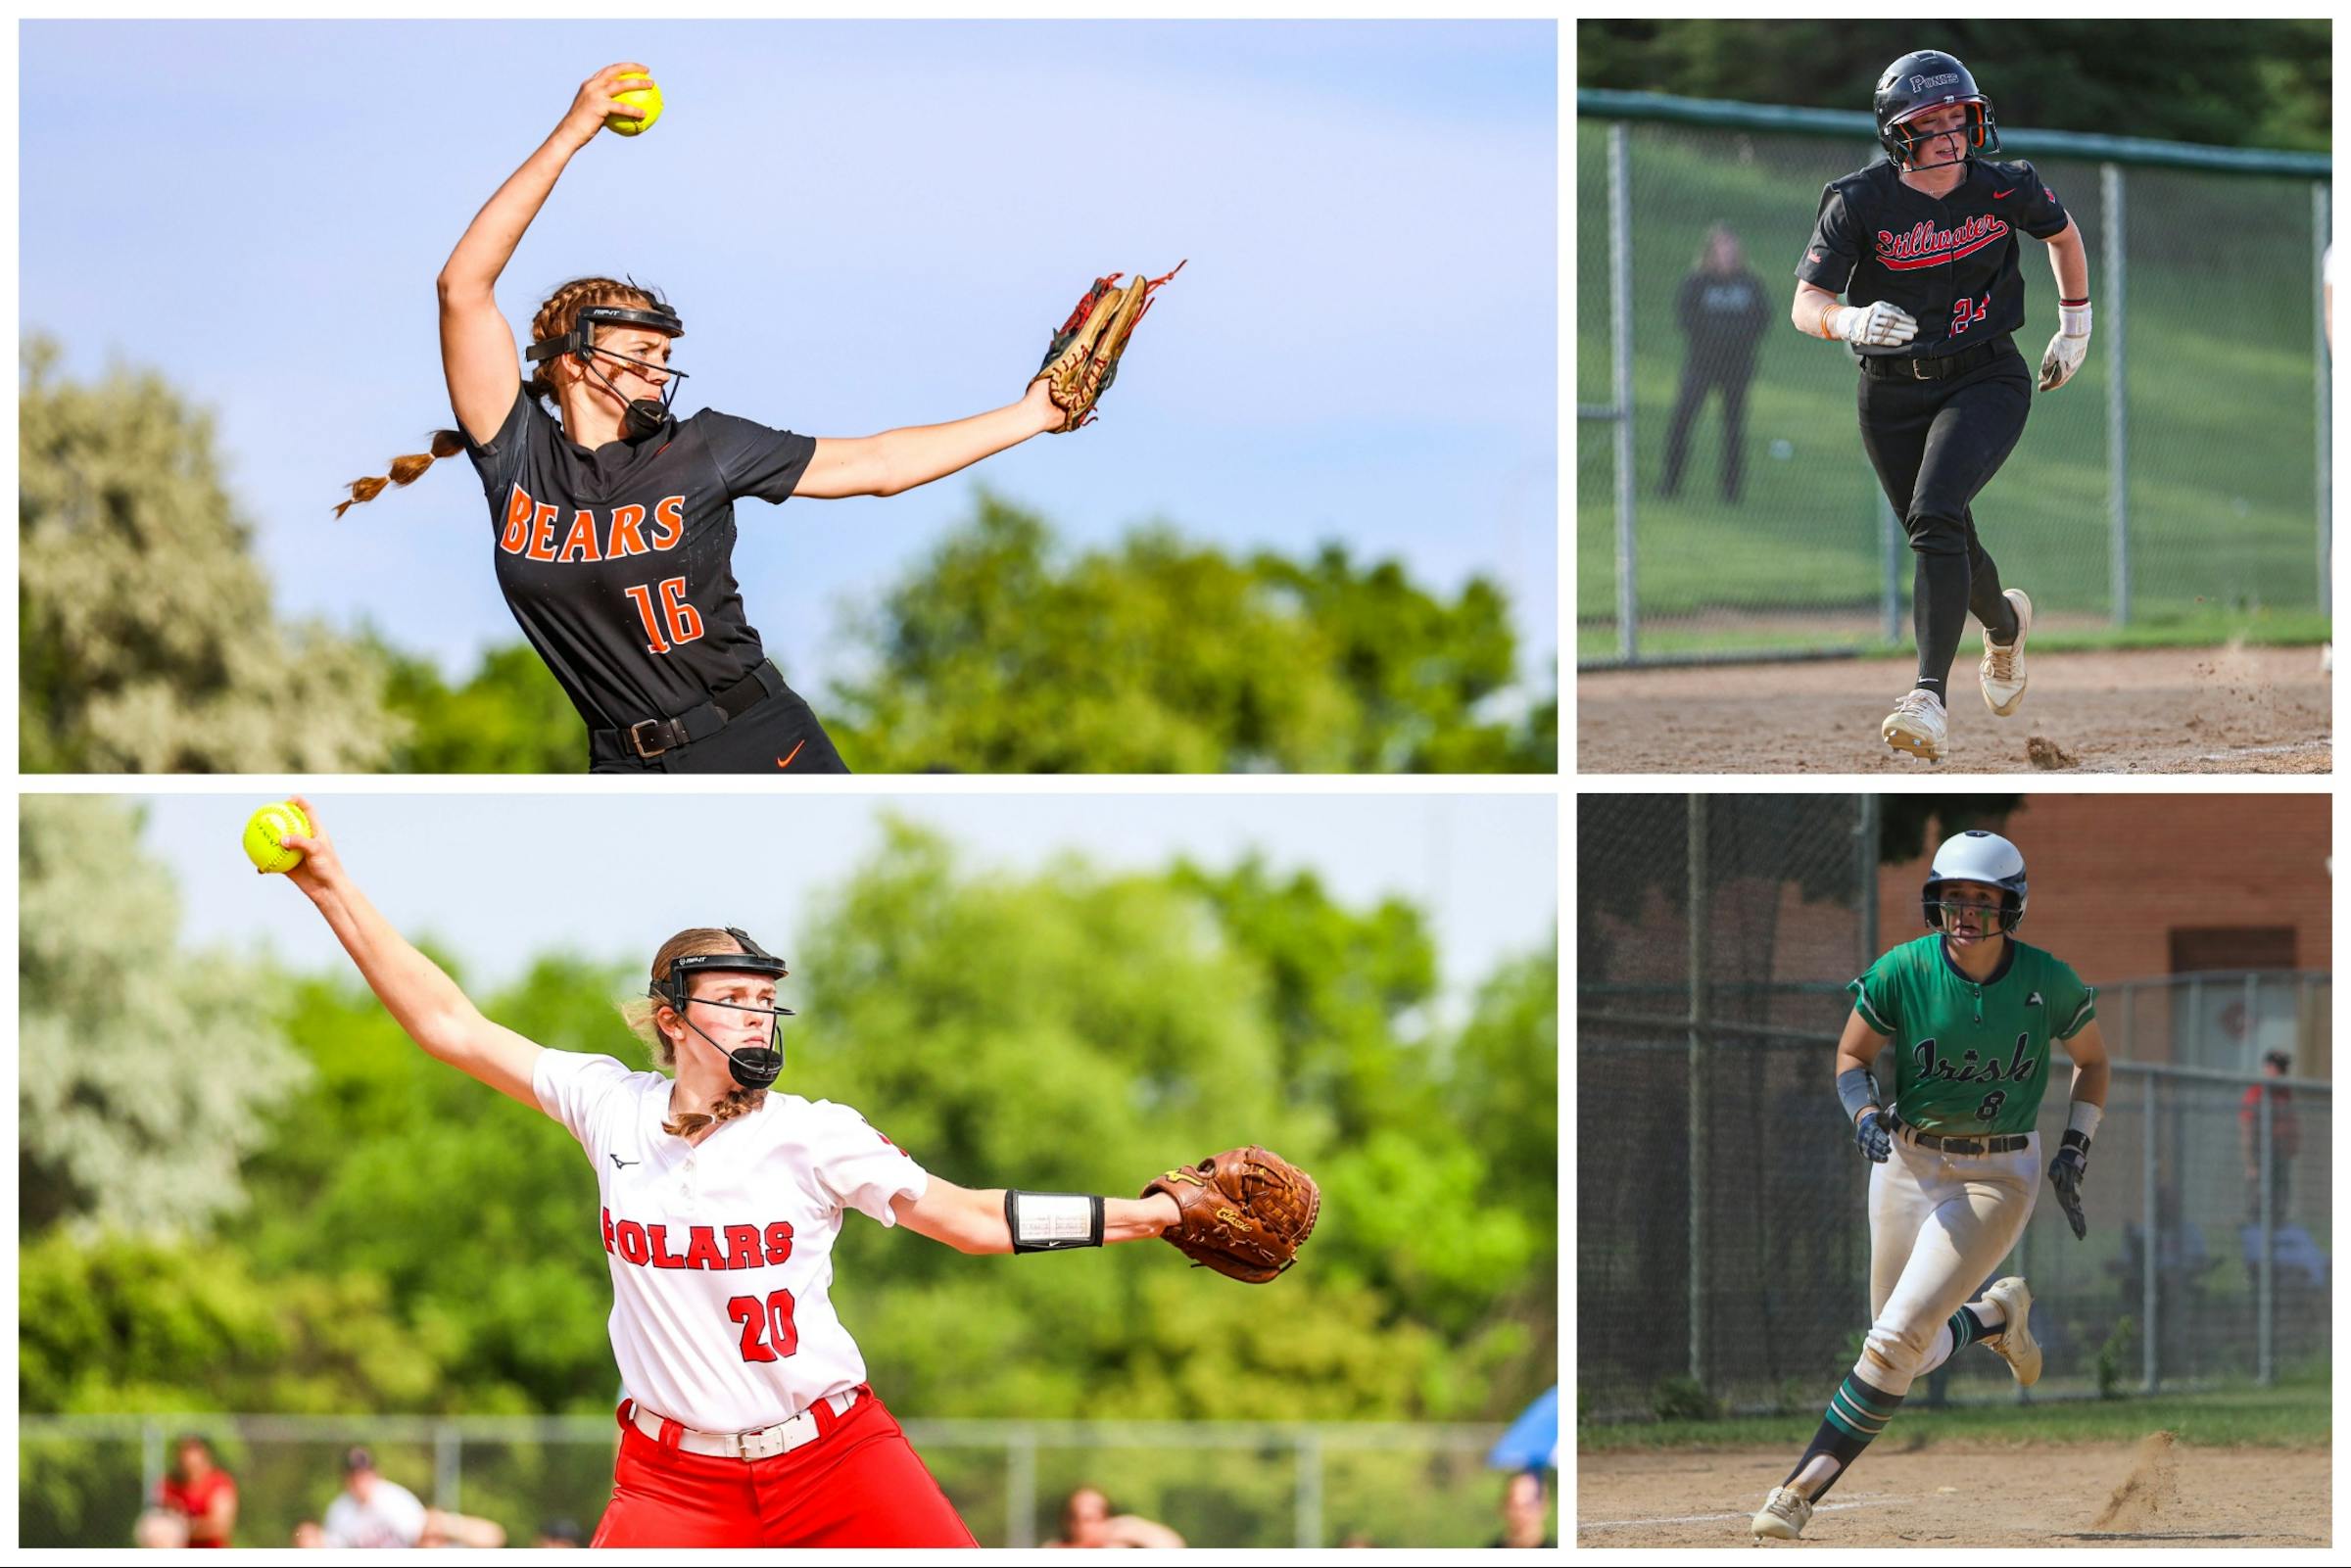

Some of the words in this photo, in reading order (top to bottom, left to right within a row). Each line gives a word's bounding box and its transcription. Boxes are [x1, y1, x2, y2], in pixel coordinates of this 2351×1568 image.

[1876, 214, 2008, 260] Stillwater
[501, 482, 685, 563] BEARS
[625, 576, 704, 655] 16
[1913, 1031, 2035, 1083] Irish
[1974, 1089, 2007, 1120] 8
[727, 1288, 799, 1363] 20
